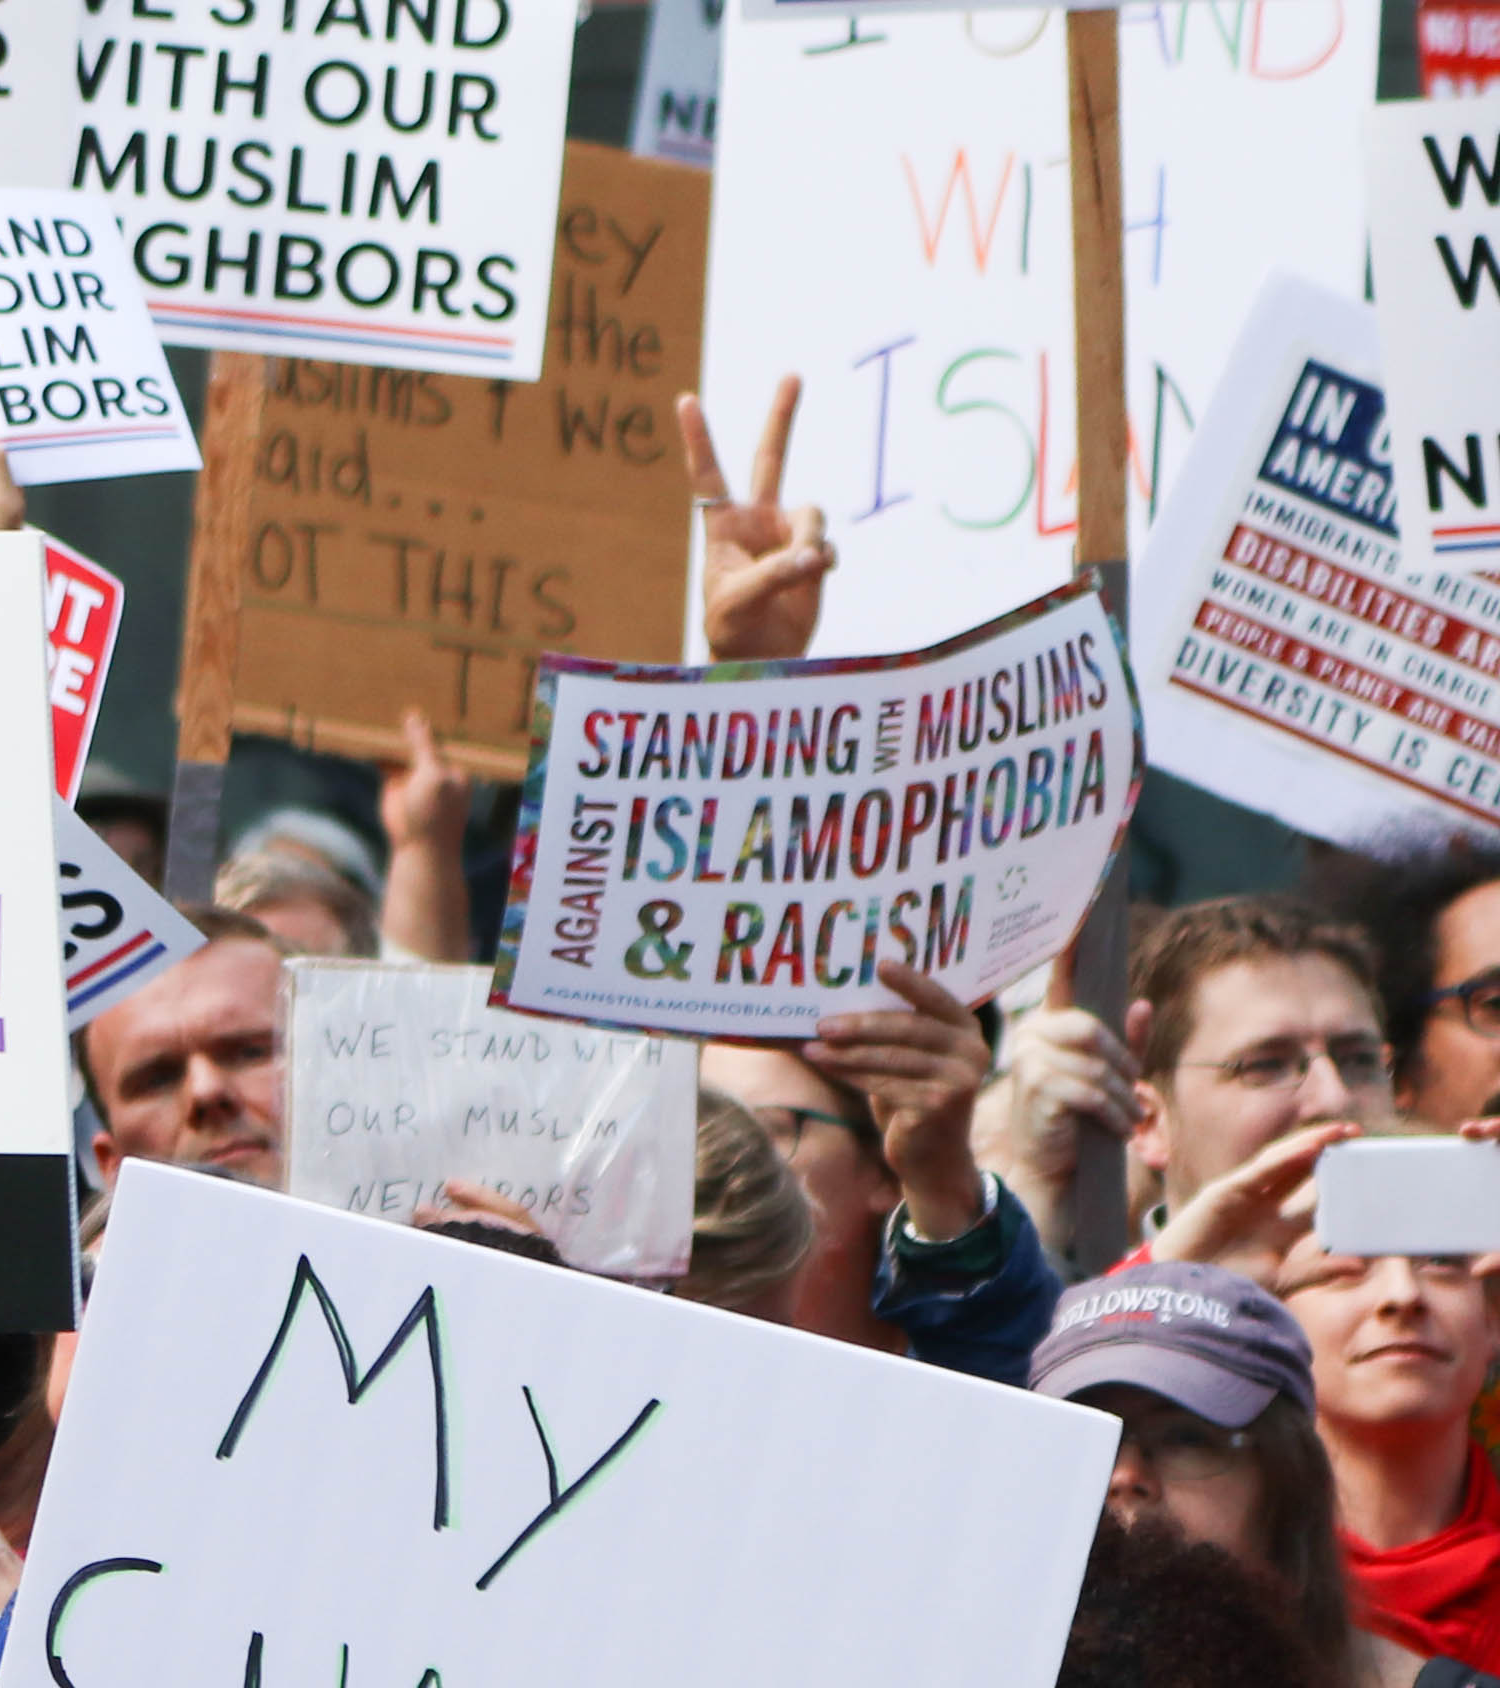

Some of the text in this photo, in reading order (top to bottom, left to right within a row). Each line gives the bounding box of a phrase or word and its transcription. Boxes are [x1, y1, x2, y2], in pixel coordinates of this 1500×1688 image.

[304, 60, 501, 141] OUR
[72, 126, 440, 224] MUSLIM
[900, 147, 1168, 286] WIH
[116, 216, 518, 322] GHBORS
[1291, 373, 1357, 447] IN
[367, 530, 576, 640] THIS
[1233, 529, 1447, 648] DISABILITIES
[1243, 491, 1400, 578] IMMIGRANTS
[1202, 607, 1285, 660] PEOPLE
[1319, 659, 1402, 710] PLANET
[1407, 698, 1453, 735] ARE
[1210, 568, 1496, 709] WOMEN ARE IN CHARGE
[578, 631, 1108, 782] STANDING WITH MUSLIMS
[1175, 635, 1374, 751] DIVERSITY
[1390, 730, 1428, 769] IS
[551, 729, 1104, 968] AGAINST ISLAMOPHOBIA
[623, 899, 695, 981] &
[714, 874, 975, 988] RACISM
[325, 1021, 663, 1066] WE STAND WITH
[542, 986, 821, 1018] AGAINSTISLAMOPHOBIA.ORG
[327, 1101, 619, 1141] OUR MUSLM
[217, 1253, 661, 1591] MY
